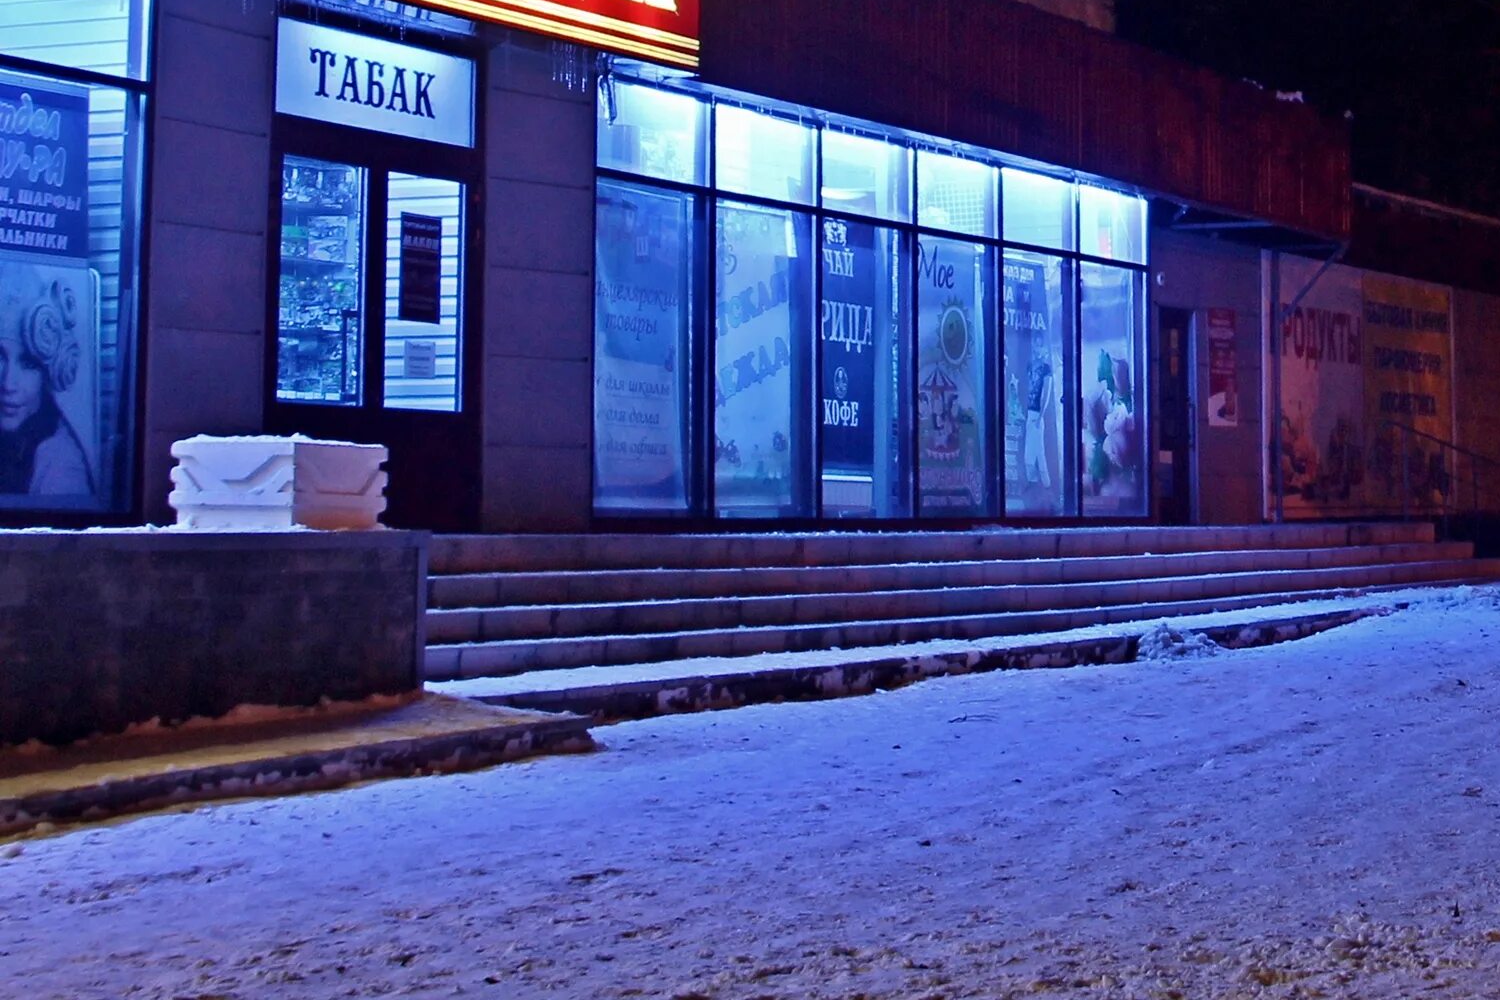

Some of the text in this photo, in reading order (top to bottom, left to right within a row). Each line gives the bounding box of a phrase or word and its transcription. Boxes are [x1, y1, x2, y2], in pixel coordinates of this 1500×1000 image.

[309, 47, 436, 119] ТАБАК
[17, 188, 82, 212] ШАРФЫ
[823, 247, 854, 278] ЧАЙ
[823, 398, 859, 428] КОФЕ
